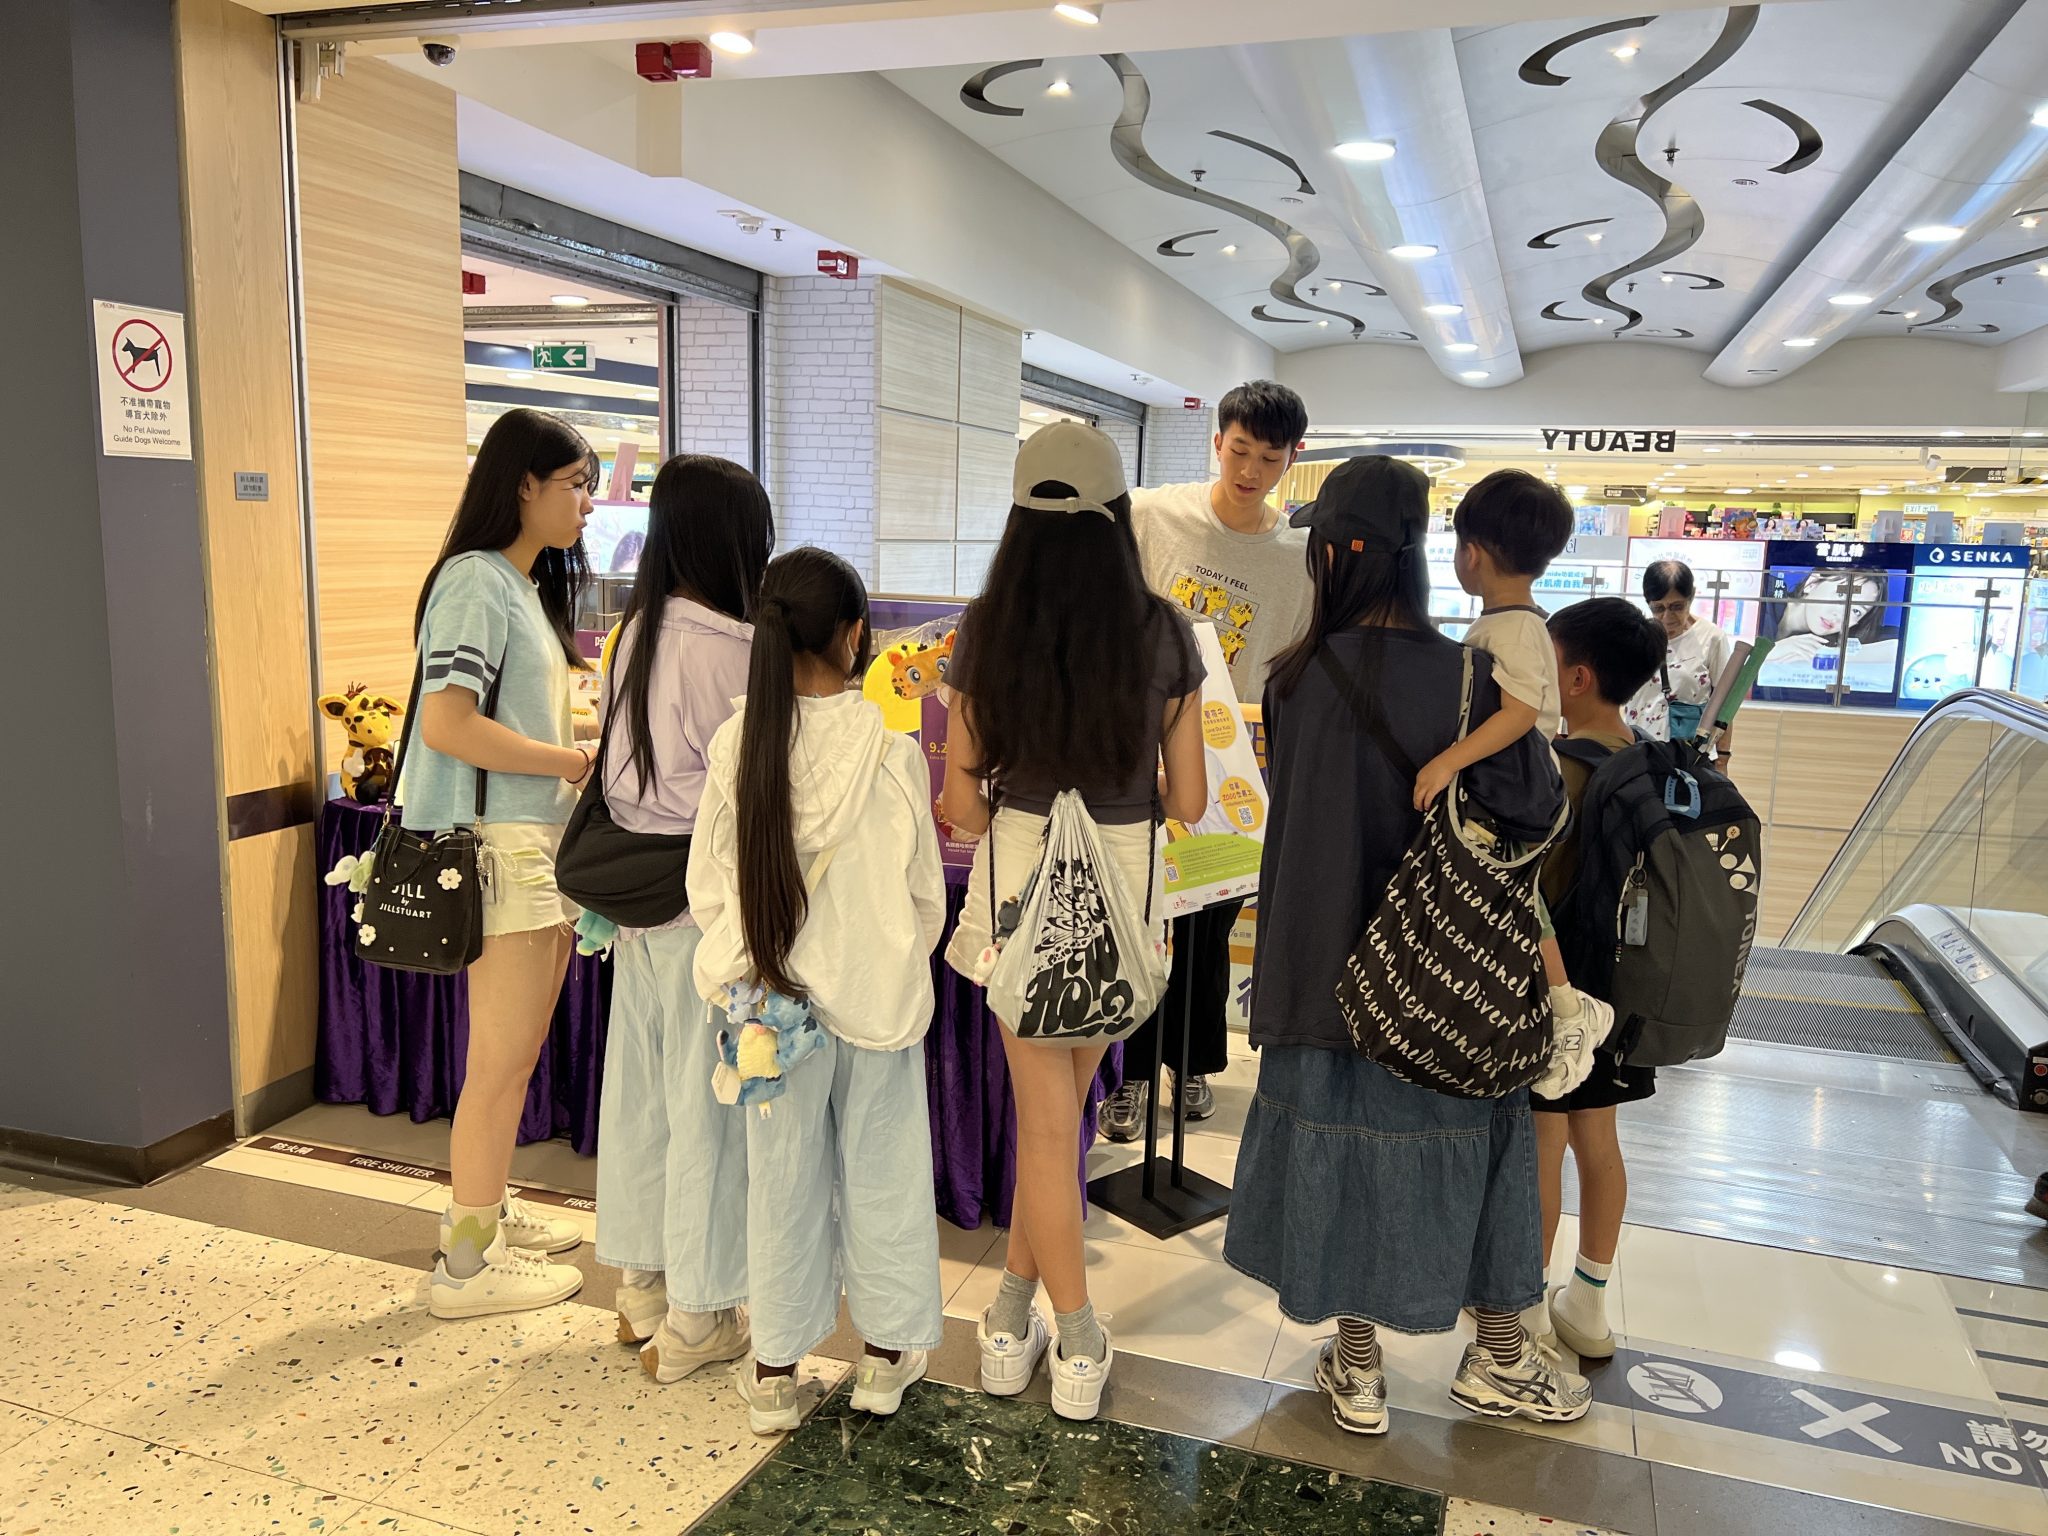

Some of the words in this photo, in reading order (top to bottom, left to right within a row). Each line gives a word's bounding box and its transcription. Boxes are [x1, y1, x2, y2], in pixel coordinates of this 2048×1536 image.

[125, 409, 167, 421] 導盲犬除外
[123, 425, 132, 433] No
[134, 426, 145, 434] Pet
[146, 426, 171, 435] Allowed
[113, 434, 133, 443] Guide
[134, 435, 151, 445] Dogs
[152, 437, 181, 446] Welcome
[1905, 505, 1921, 513] EXIT
[1951, 550, 2013, 563] SENKA
[1195, 565, 1224, 581] TODAY
[1229, 578, 1249, 592] FEEL
[391, 883, 426, 899] JILL
[400, 897, 410, 907] by
[378, 902, 432, 919] JILLSTUART
[350, 1156, 377, 1168] FIRE
[377, 1162, 436, 1179] SHUTTER
[564, 1198, 595, 1209] FIRE
[1939, 1441, 2023, 1476] NO
